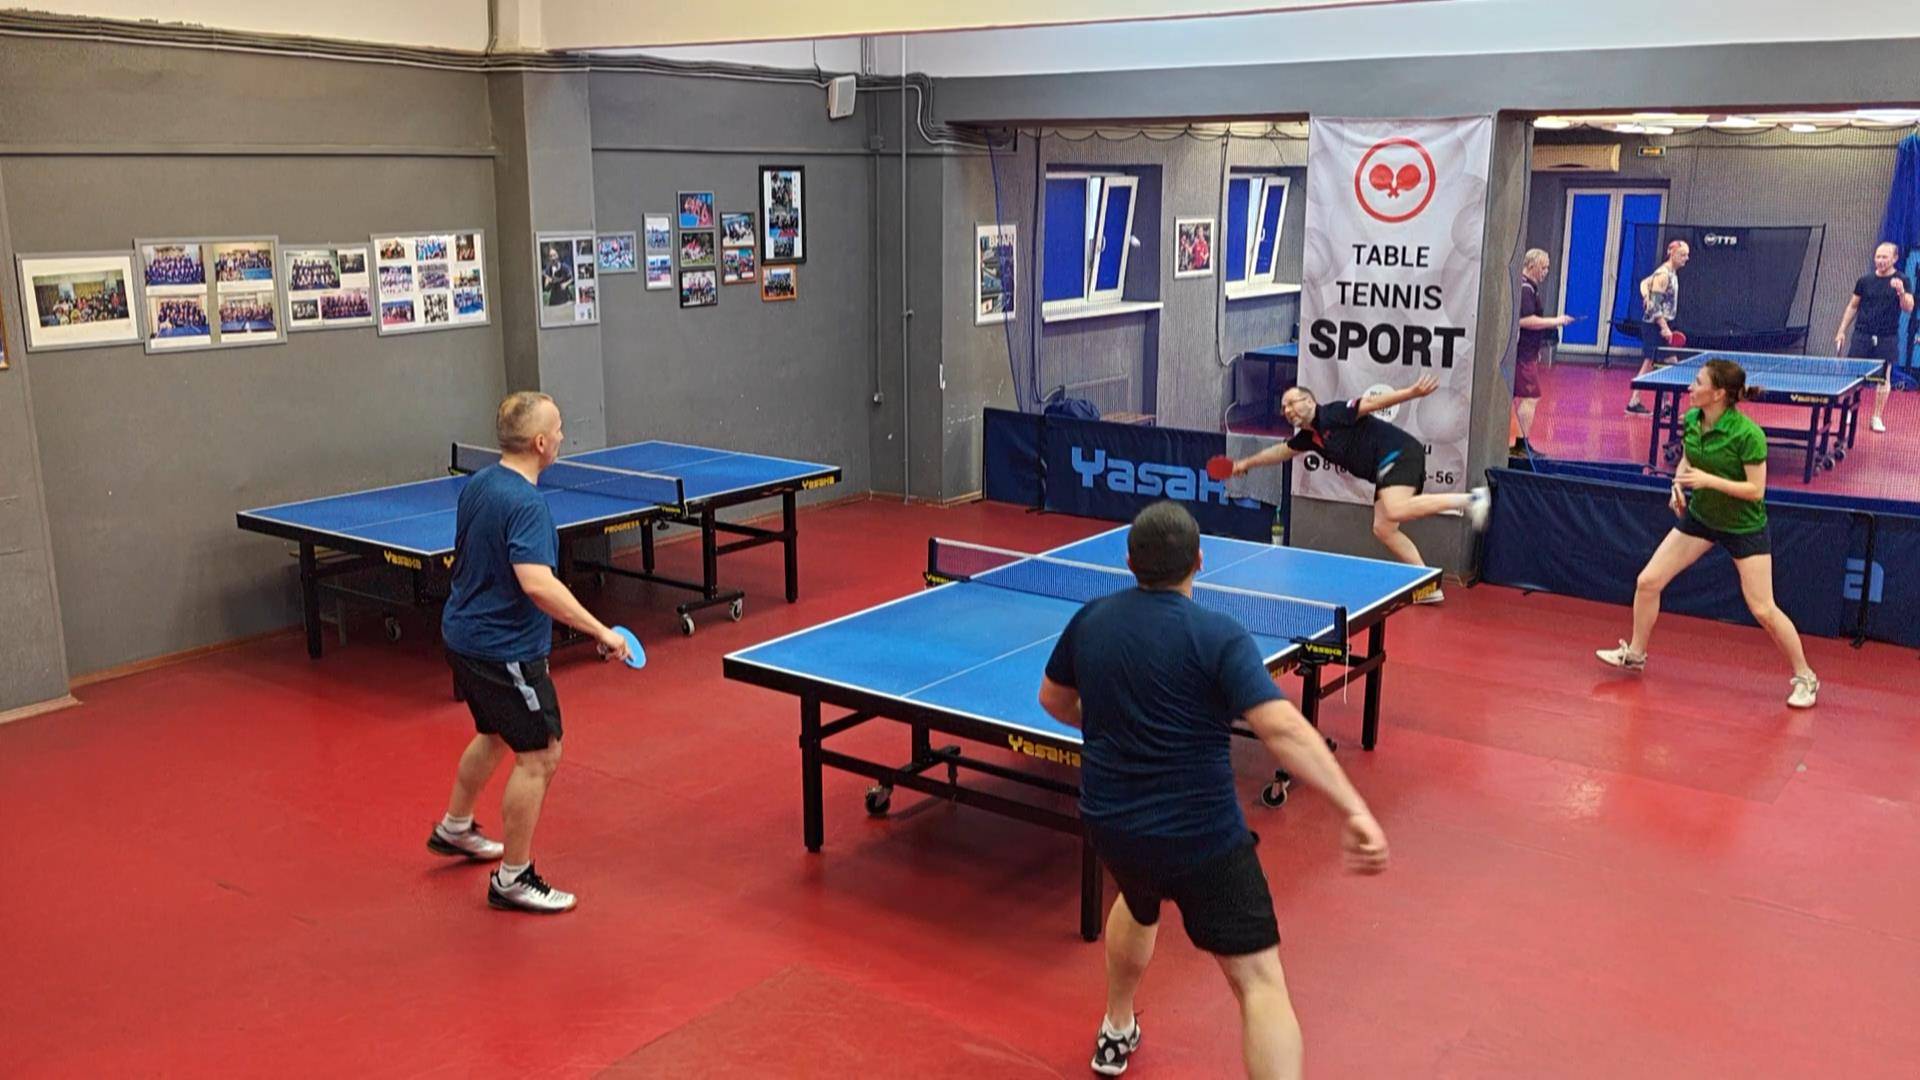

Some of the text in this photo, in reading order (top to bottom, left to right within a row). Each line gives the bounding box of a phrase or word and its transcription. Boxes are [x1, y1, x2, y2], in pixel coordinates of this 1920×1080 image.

[1352, 244, 1430, 268] TABLE
[1336, 280, 1442, 310] TENNIS
[1309, 319, 1465, 368] SPORT
[1008, 733, 1082, 768] Yasaka
